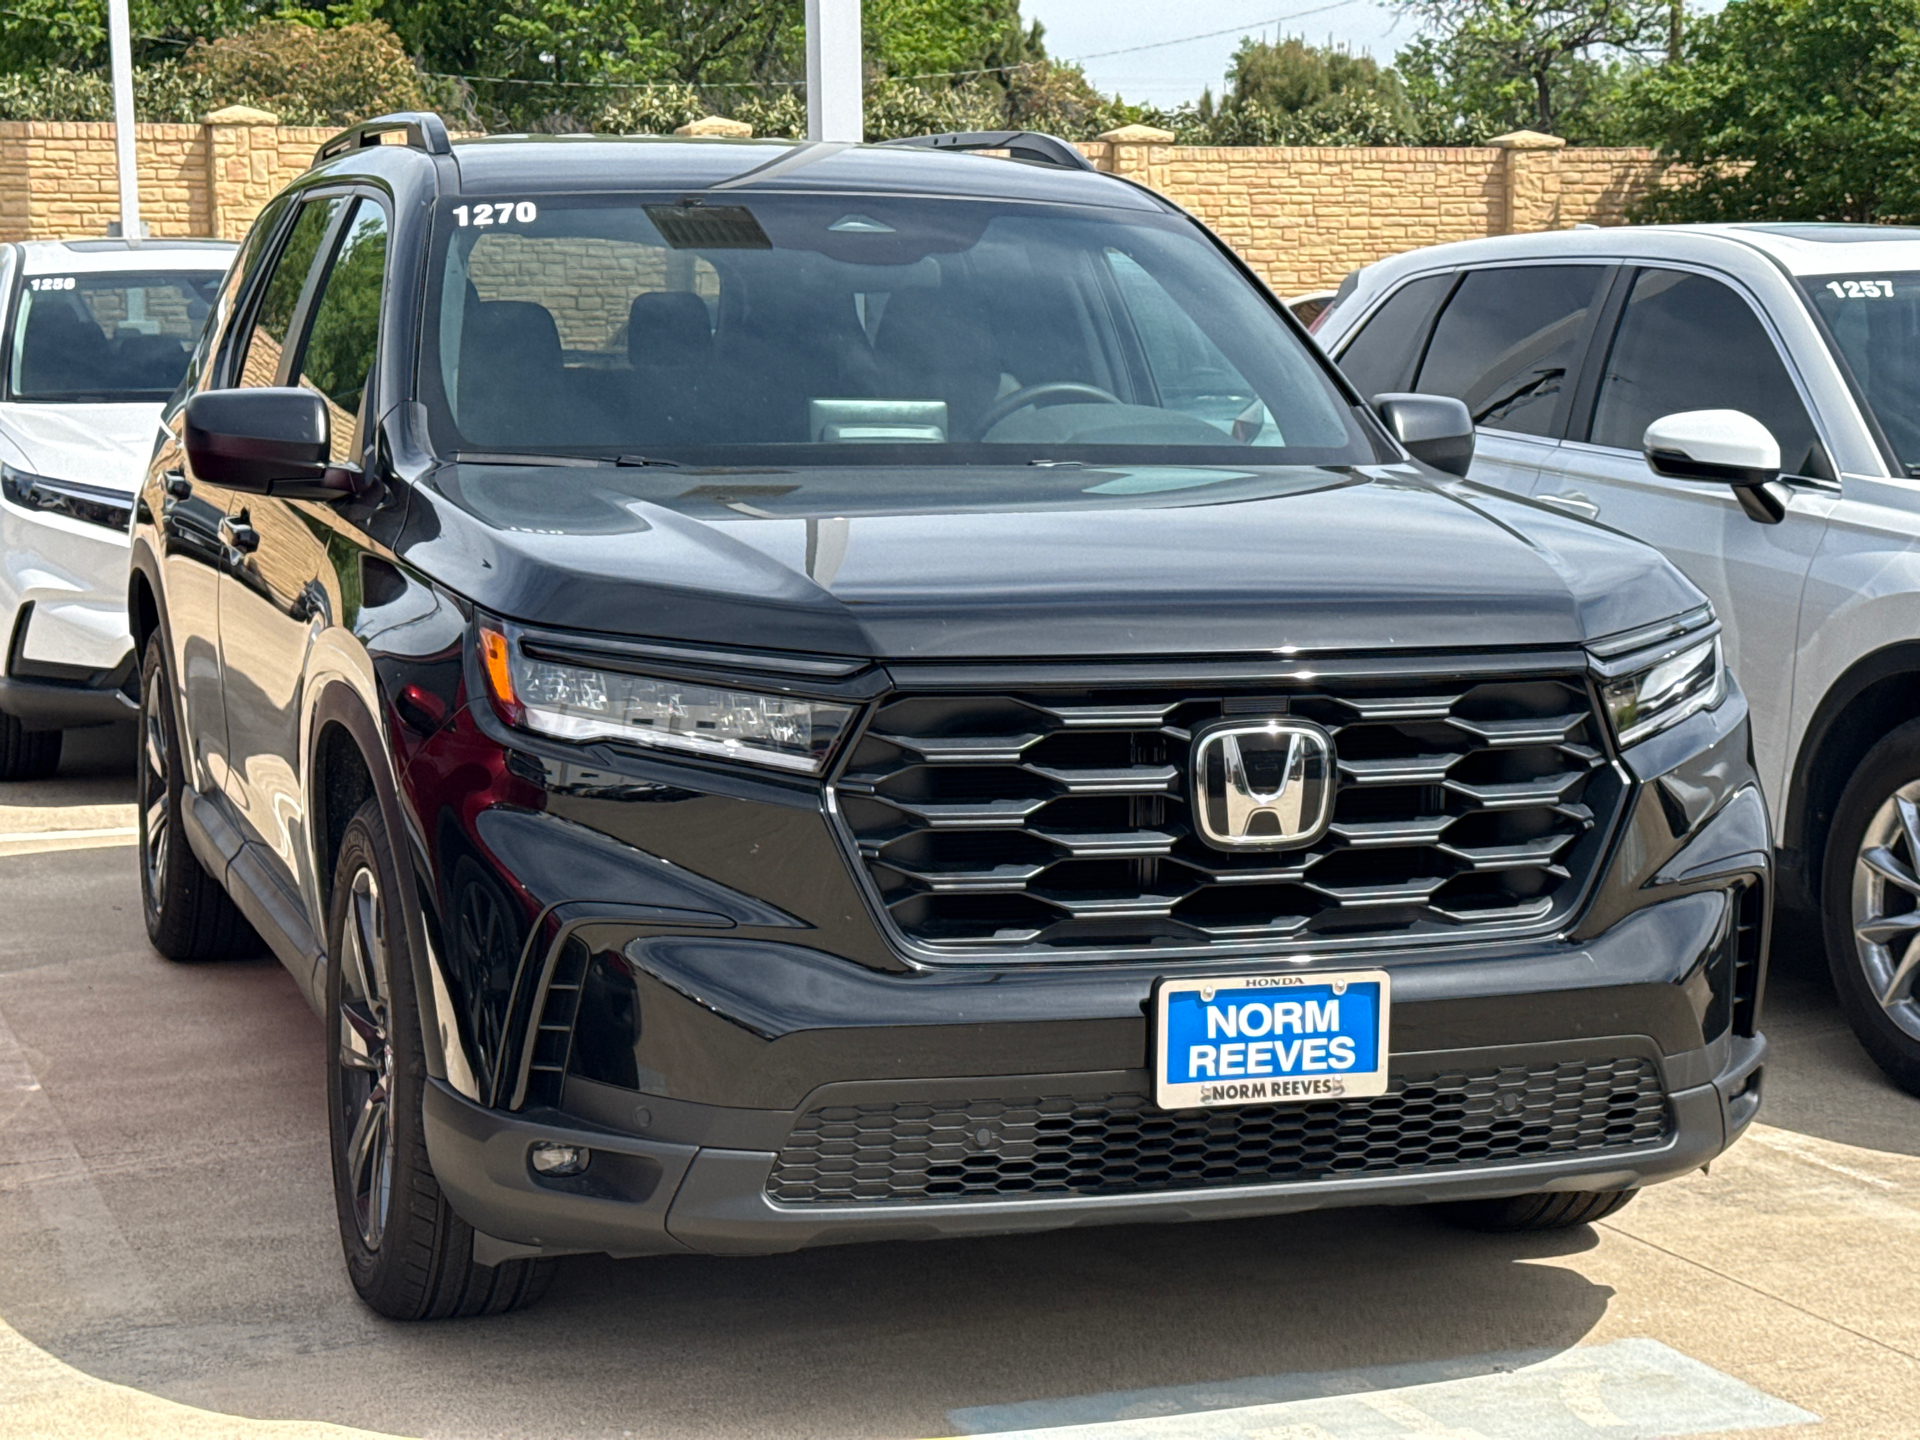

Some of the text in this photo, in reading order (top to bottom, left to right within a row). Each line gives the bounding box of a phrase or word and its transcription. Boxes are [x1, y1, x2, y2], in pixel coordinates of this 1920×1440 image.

[452, 201, 537, 227] 1270
[1825, 281, 1895, 298] 1257
[1245, 977, 1305, 987] HONDA
[1206, 1000, 1340, 1039] NORM
[1188, 1036, 1356, 1078] REEVES
[1212, 1079, 1332, 1101] NORM REEVES
